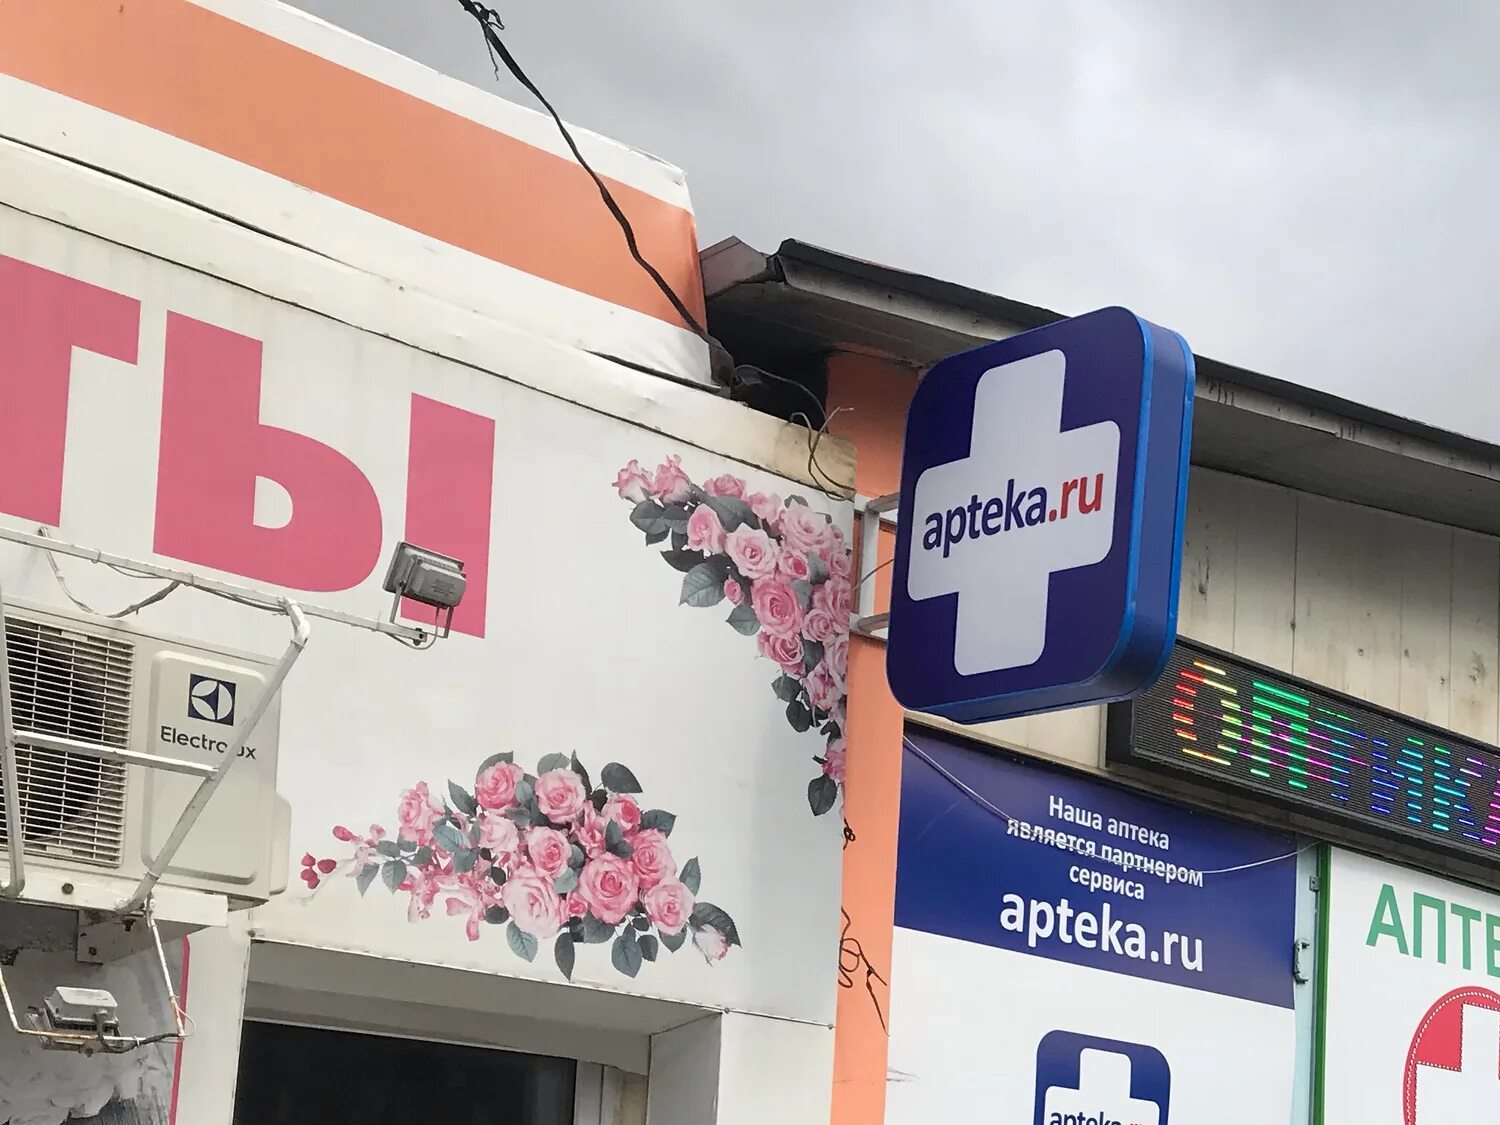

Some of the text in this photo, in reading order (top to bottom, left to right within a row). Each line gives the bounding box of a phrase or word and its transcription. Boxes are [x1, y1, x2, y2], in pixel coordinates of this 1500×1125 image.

[923, 473, 1104, 558] apteka.ru
[161, 725, 257, 760] Electroux
[1007, 819, 1204, 887] является партнером
[1050, 795, 1170, 850] Наша аптека
[1069, 865, 1145, 900] сервиса
[1000, 893, 1204, 972] apteka.ru
